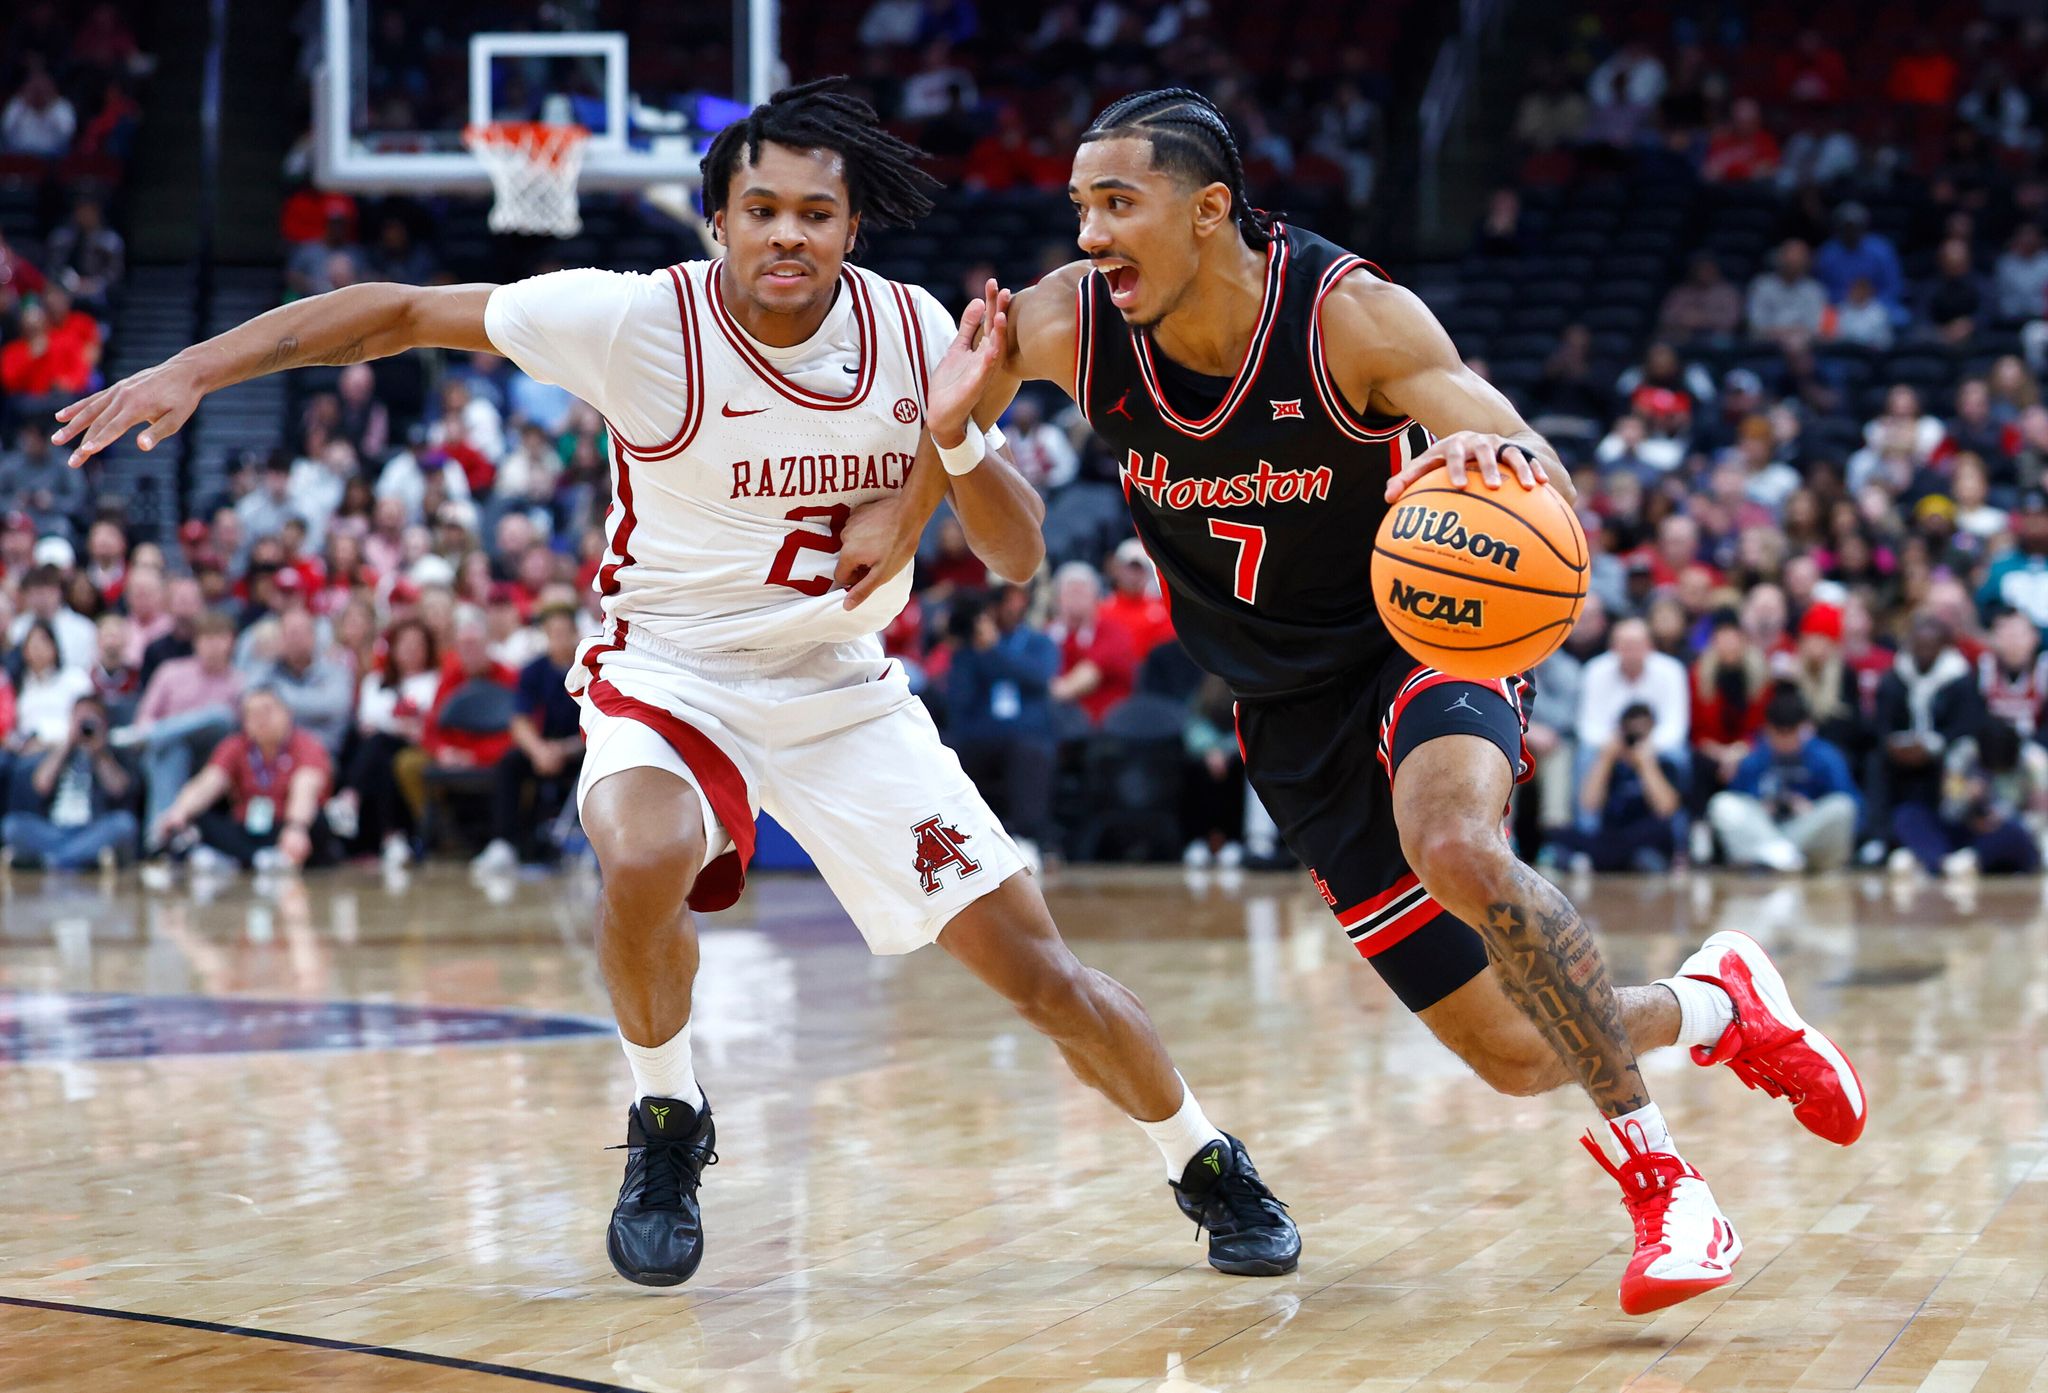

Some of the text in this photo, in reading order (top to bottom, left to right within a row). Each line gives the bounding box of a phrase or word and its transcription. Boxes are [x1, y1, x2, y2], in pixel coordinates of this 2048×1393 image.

[894, 400, 917, 422] SEC
[1124, 448, 1333, 510] Houston
[765, 503, 861, 597] 2
[1208, 518, 1267, 605] 7
[1391, 506, 1520, 572] Wilson
[1389, 578, 1482, 627] NCAA
